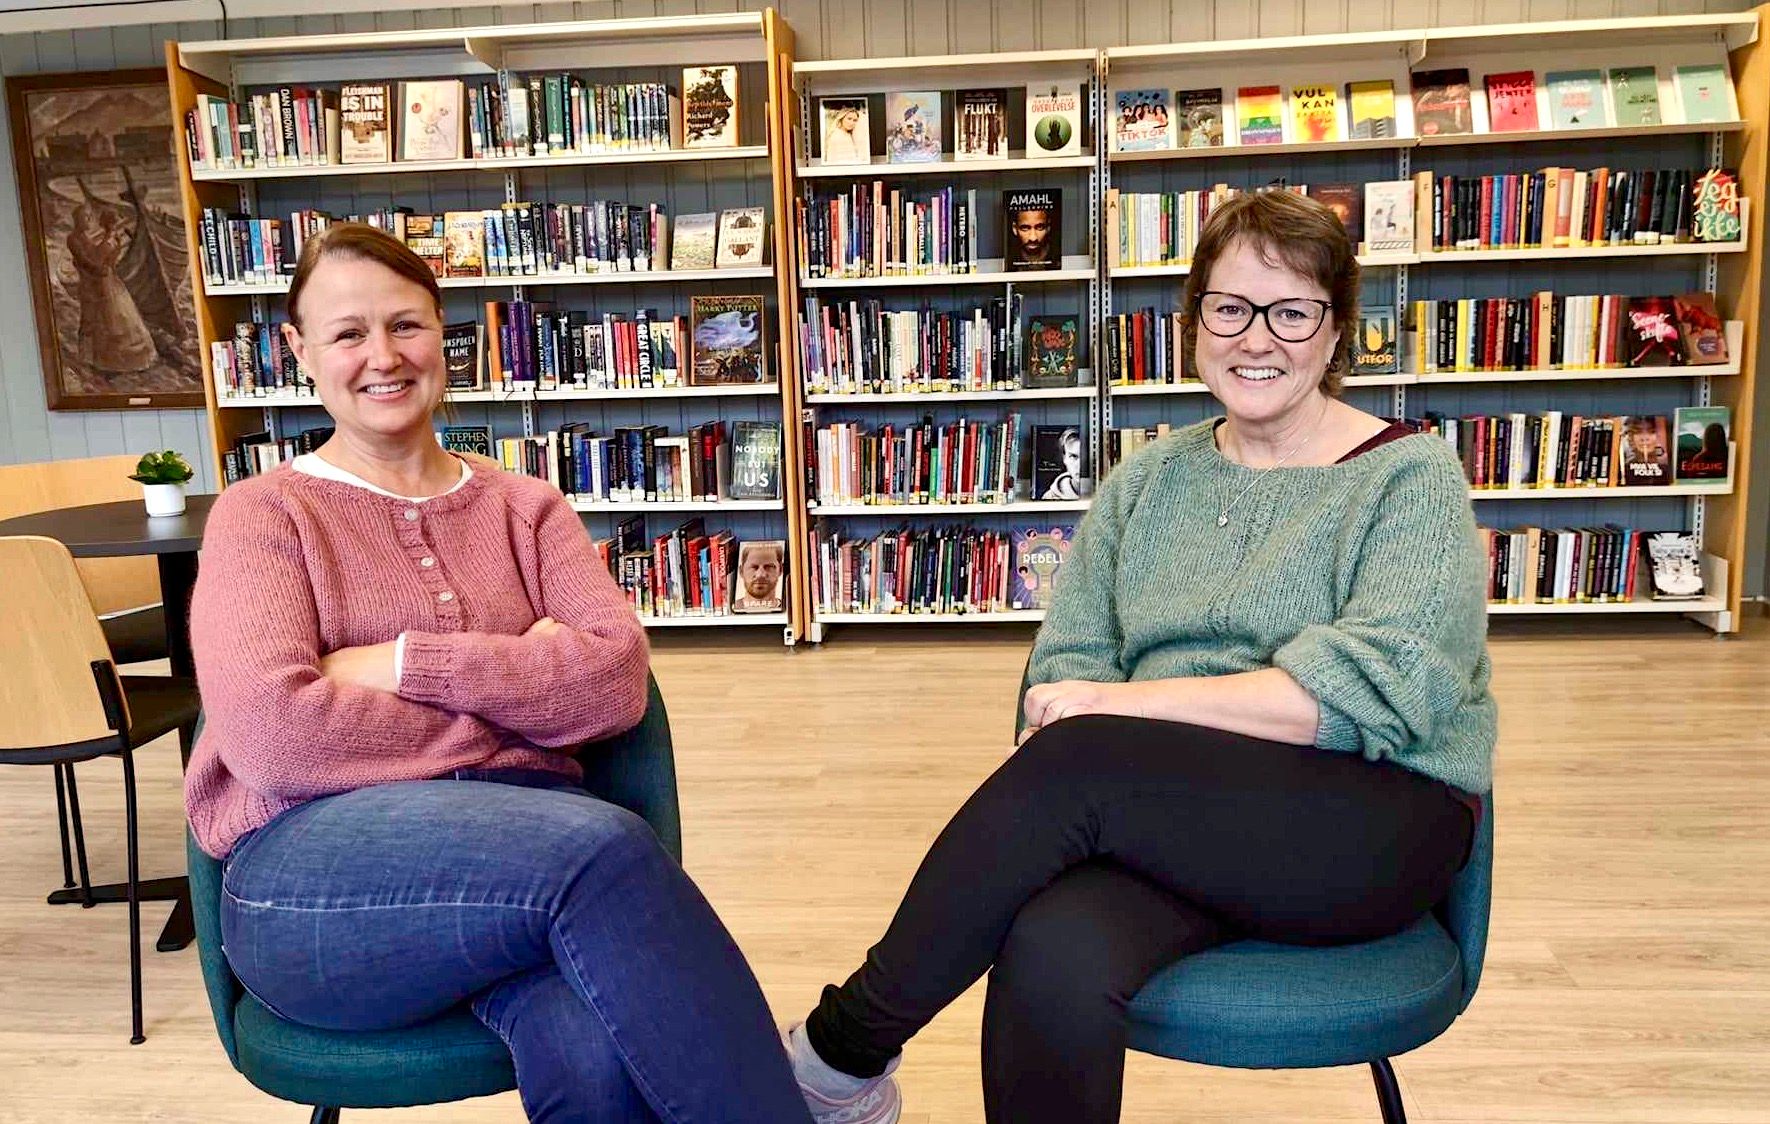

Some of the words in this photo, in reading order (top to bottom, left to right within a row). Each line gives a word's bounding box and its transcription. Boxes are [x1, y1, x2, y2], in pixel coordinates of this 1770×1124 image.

[281, 88, 291, 106] DAN
[1293, 88, 1326, 98] VUL
[342, 97, 361, 111] IS
[364, 96, 383, 110] IN
[964, 103, 997, 115] FLUKT
[1302, 99, 1334, 109] KAN
[342, 111, 383, 122] TROUBLE
[283, 107, 294, 146] BROWN
[1010, 194, 1053, 206] AMAHL
[207, 226, 217, 255] CHILD
[727, 303, 758, 312] POTTER
[637, 323, 649, 350] GREAT
[450, 347, 469, 358] NAME
[638, 351, 652, 381] CIRCLE
[444, 432, 490, 443] STEPHEN
[450, 442, 486, 454] KING
[735, 445, 780, 454] NOBODY
[744, 472, 770, 488] US
